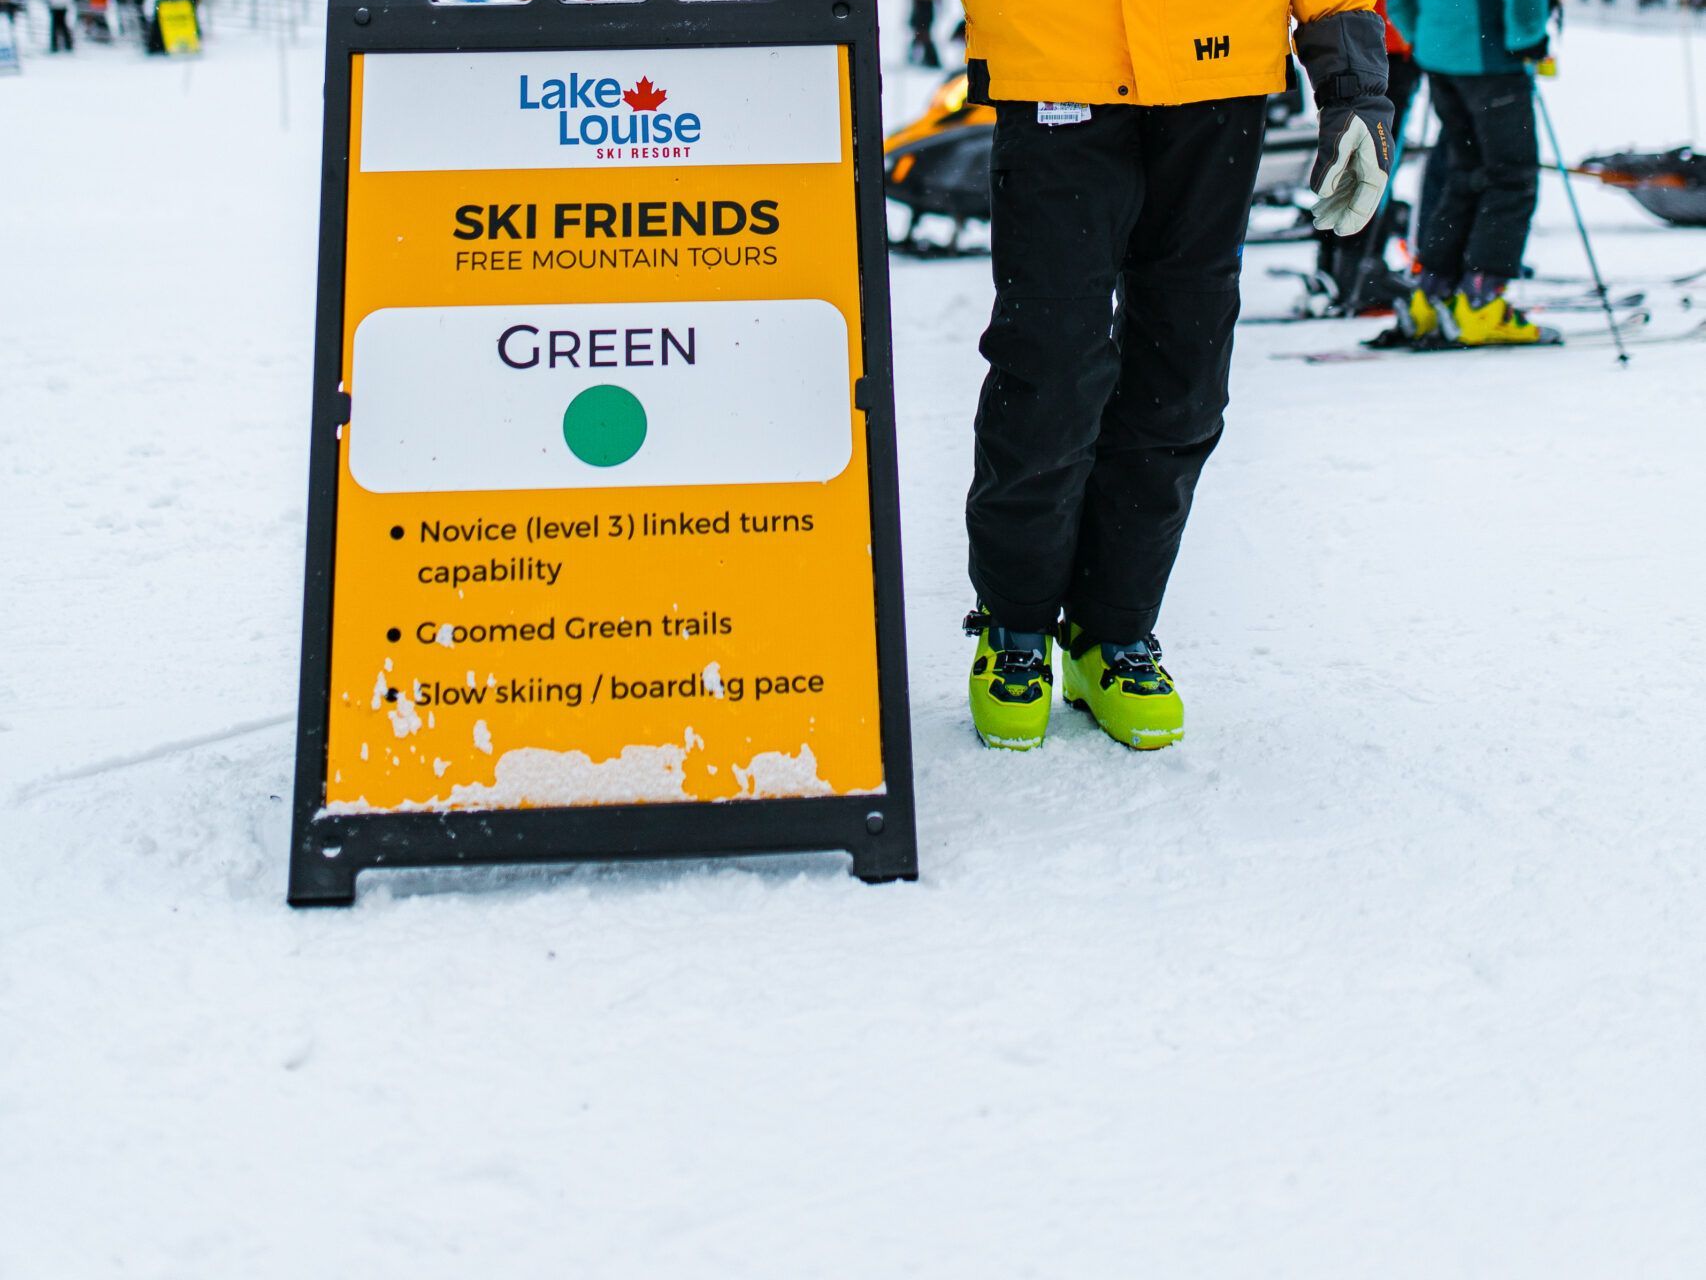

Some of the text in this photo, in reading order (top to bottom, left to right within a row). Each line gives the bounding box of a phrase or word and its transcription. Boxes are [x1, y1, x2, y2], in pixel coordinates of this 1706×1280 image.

[1193, 35, 1230, 61] HH
[519, 72, 622, 110] Lake
[559, 111, 701, 146] Louise
[1376, 121, 1389, 160] HESTRA
[596, 146, 692, 160] SKI RESORT
[452, 200, 780, 241] SKI FRIENDS
[456, 245, 778, 271] FREE MOUNTAIN TOURS
[496, 324, 697, 370] GREEN
[420, 512, 814, 543] Novice (level 3) linked turns
[417, 557, 562, 589] capability
[416, 611, 732, 644] Goomed Green trails
[415, 682, 487, 707] Slow
[496, 678, 582, 707] skiing
[591, 674, 603, 704] /
[755, 675, 825, 700] pace
